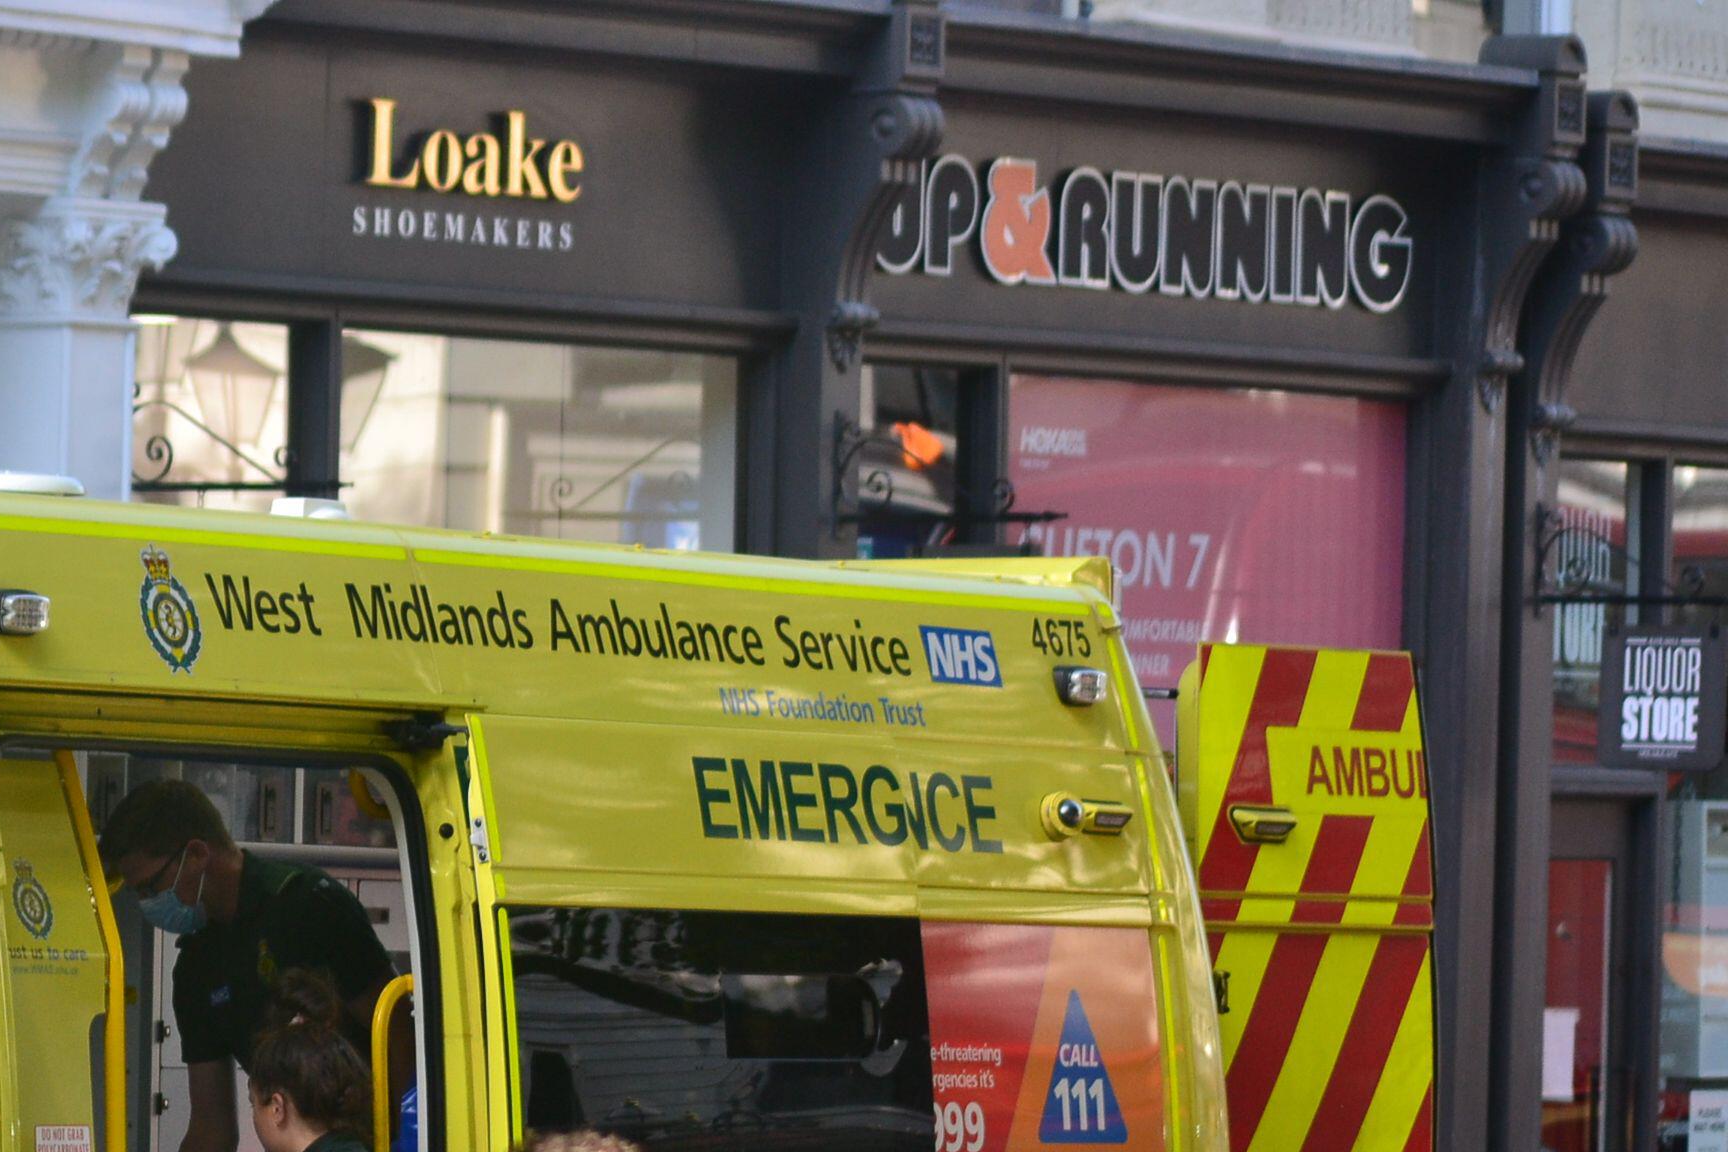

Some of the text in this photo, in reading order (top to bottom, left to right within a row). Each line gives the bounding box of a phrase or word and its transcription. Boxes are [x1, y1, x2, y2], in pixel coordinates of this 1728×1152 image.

[367, 97, 585, 203] Loake
[353, 206, 574, 250] SHOEMAKERS
[1185, 534, 1210, 591] 7
[204, 573, 996, 682] West Midlands Ambulance Service NHS
[1032, 618, 1091, 658] 4675
[1624, 646, 1702, 696] LIQUOR
[719, 687, 927, 727] NHS Foundation Trust
[1621, 695, 1700, 741] STORE
[930, 1042, 1002, 1065] e-threatening
[1059, 1044, 1099, 1067] CALL
[979, 1070, 995, 1087] it's
[1053, 1078, 1105, 1131] 111
[41, 1127, 84, 1141] DO NOT GRAB
